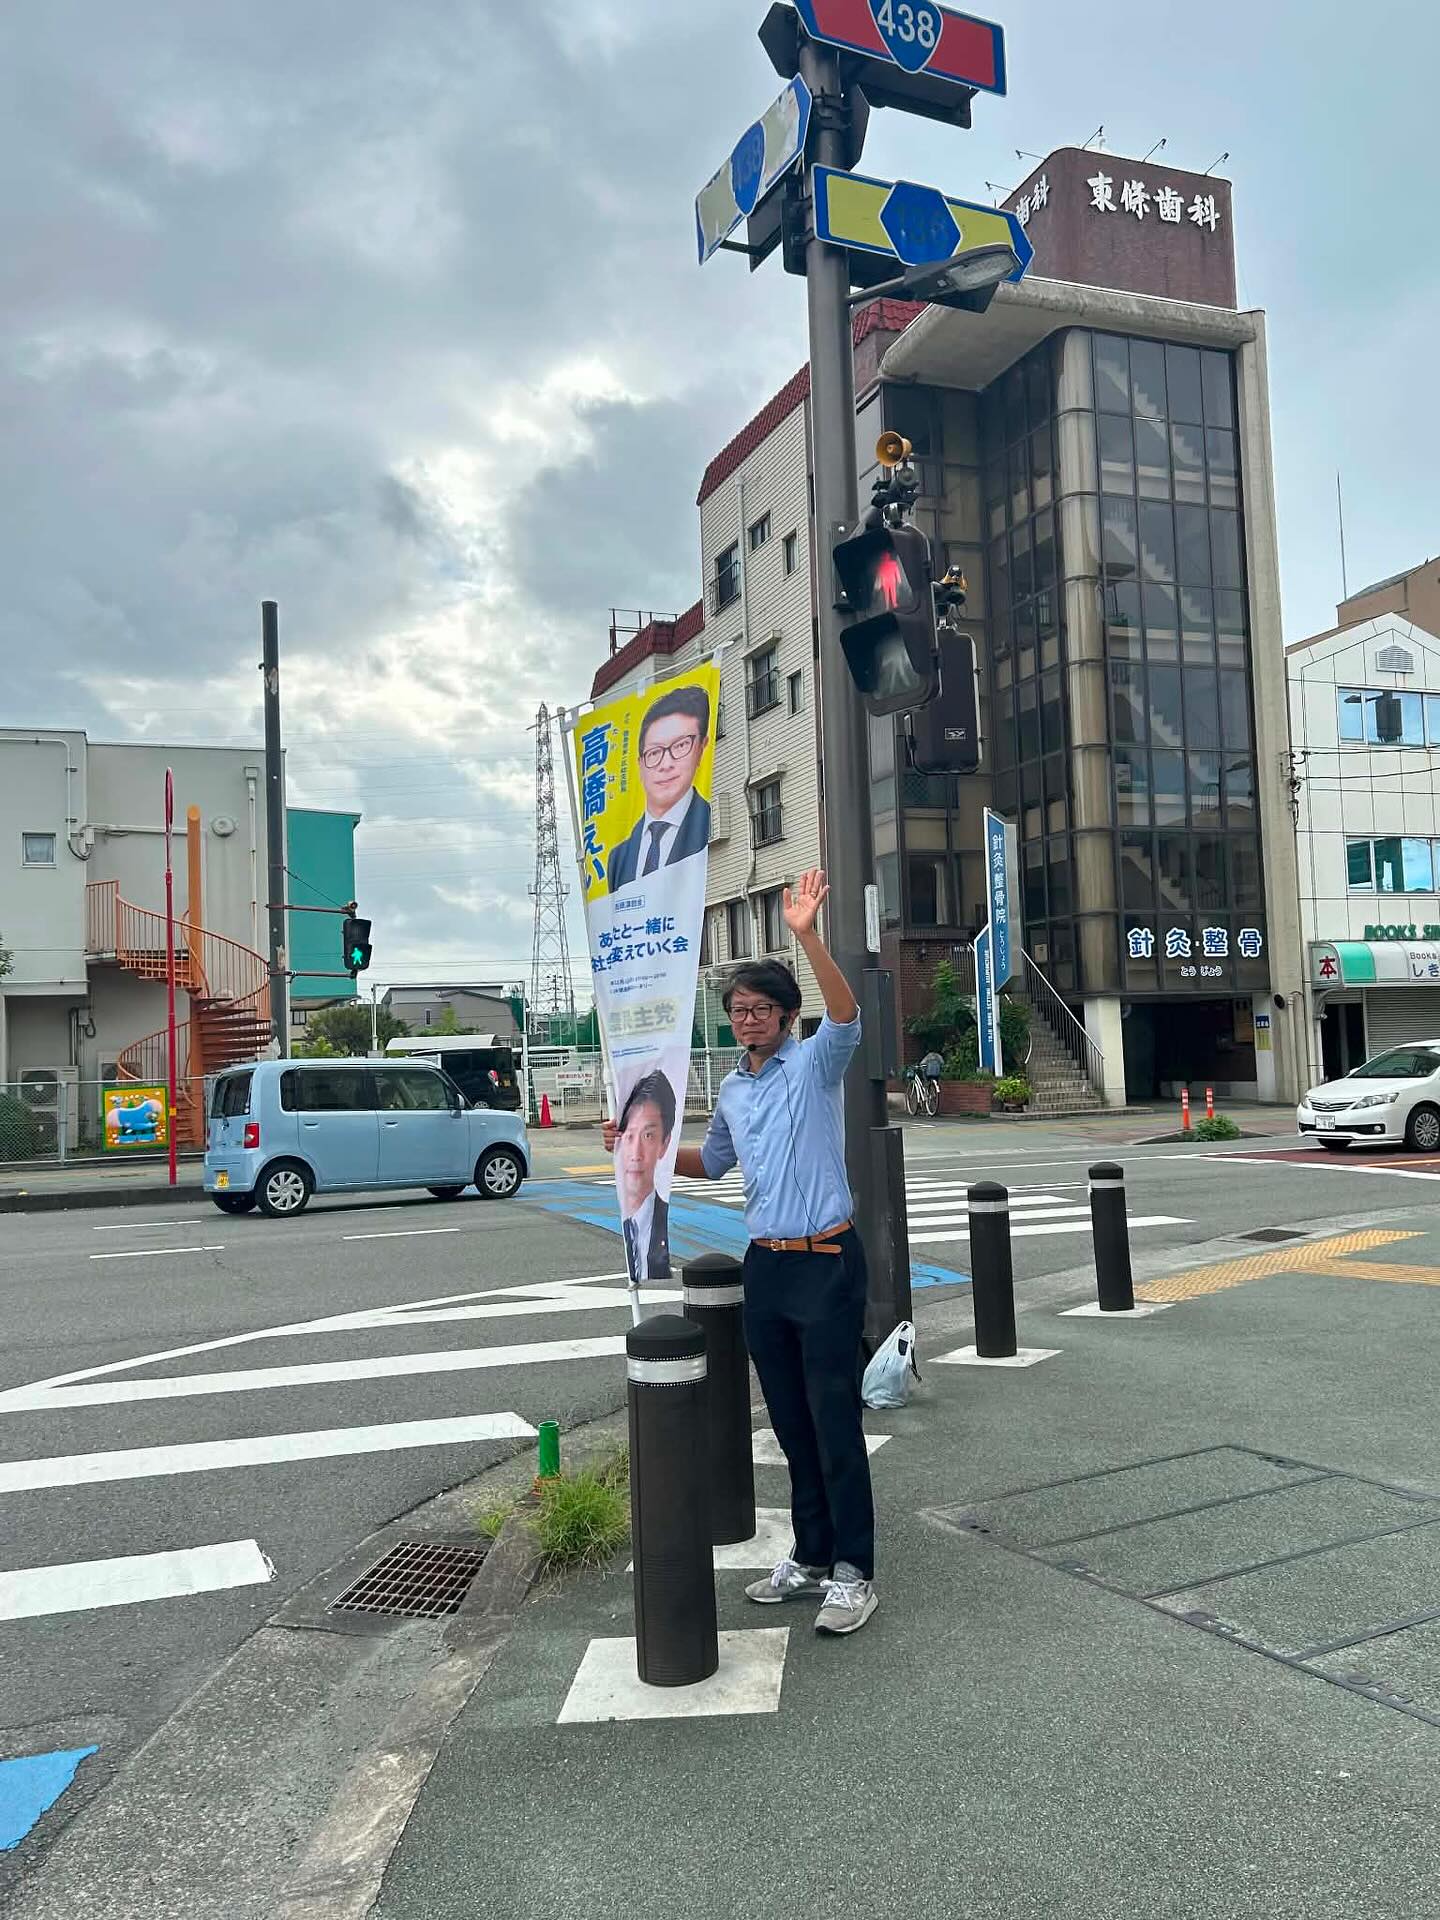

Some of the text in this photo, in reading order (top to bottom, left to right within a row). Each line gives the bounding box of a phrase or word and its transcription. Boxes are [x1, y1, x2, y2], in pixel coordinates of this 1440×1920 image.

[877, 0, 935, 48] 438
[1087, 171, 1220, 232] 東條歯科
[1127, 927, 1262, 958] 針灸・整骨
[1364, 924, 1417, 940] BOOKS
[1319, 956, 1337, 979] 本
